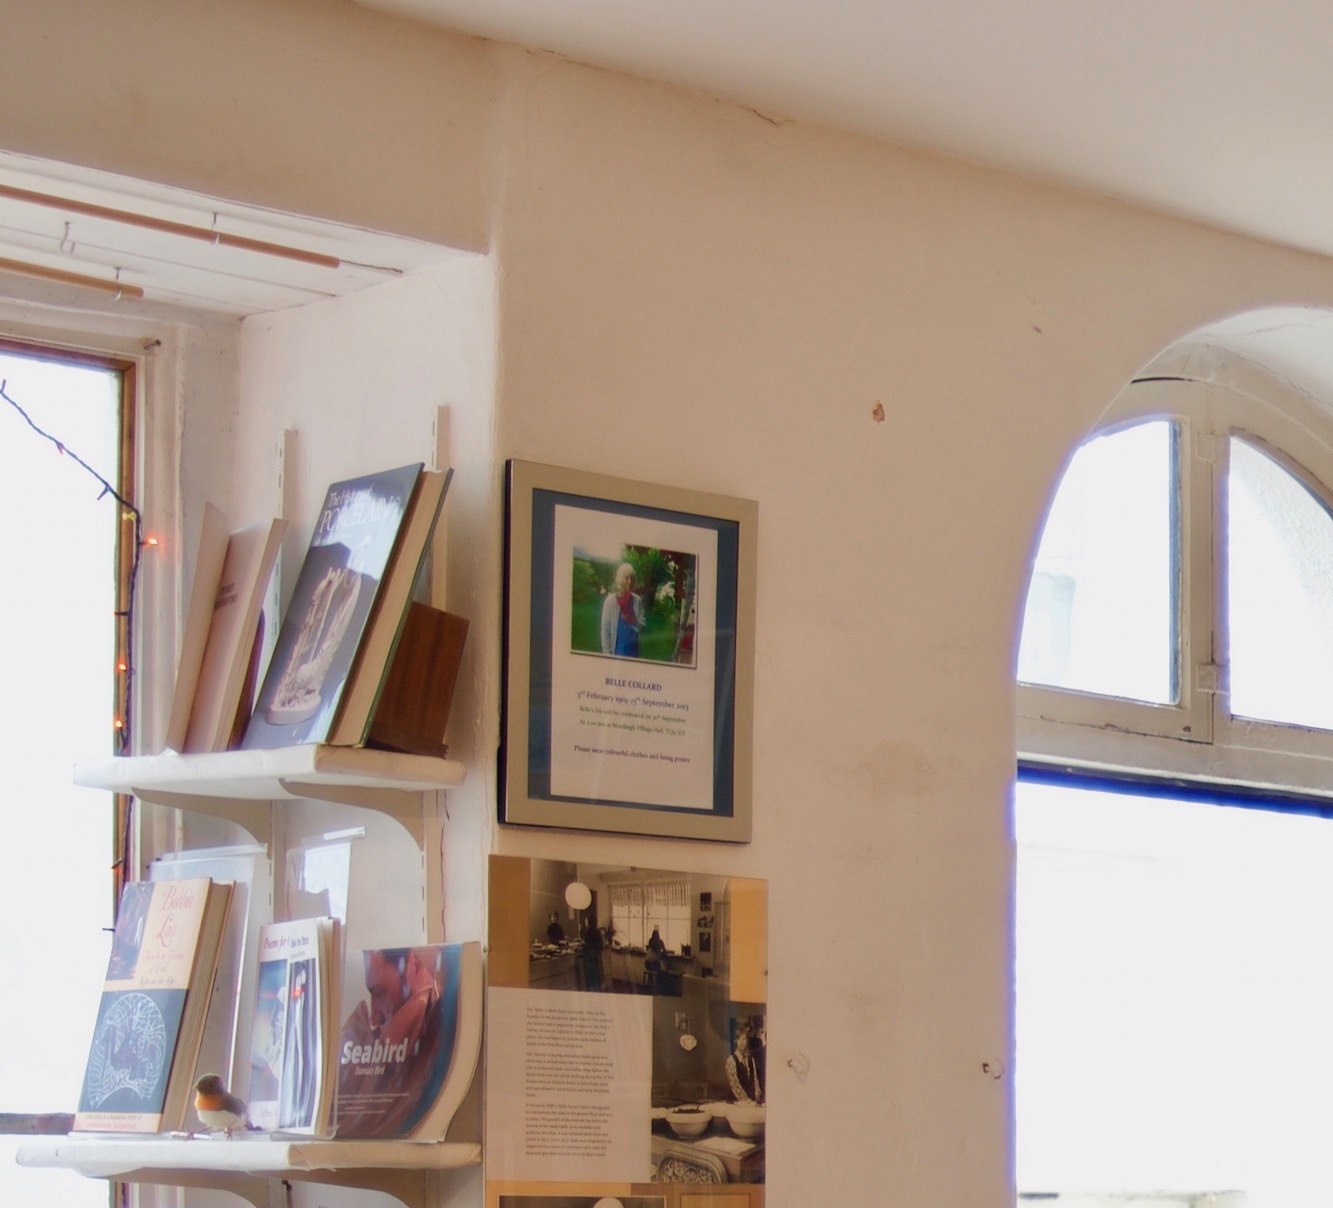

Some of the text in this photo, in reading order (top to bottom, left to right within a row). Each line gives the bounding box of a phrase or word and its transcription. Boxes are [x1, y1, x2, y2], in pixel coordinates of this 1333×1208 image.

[605, 678, 662, 691] BELLE COLLARD
[341, 1038, 408, 1065] Seabird
